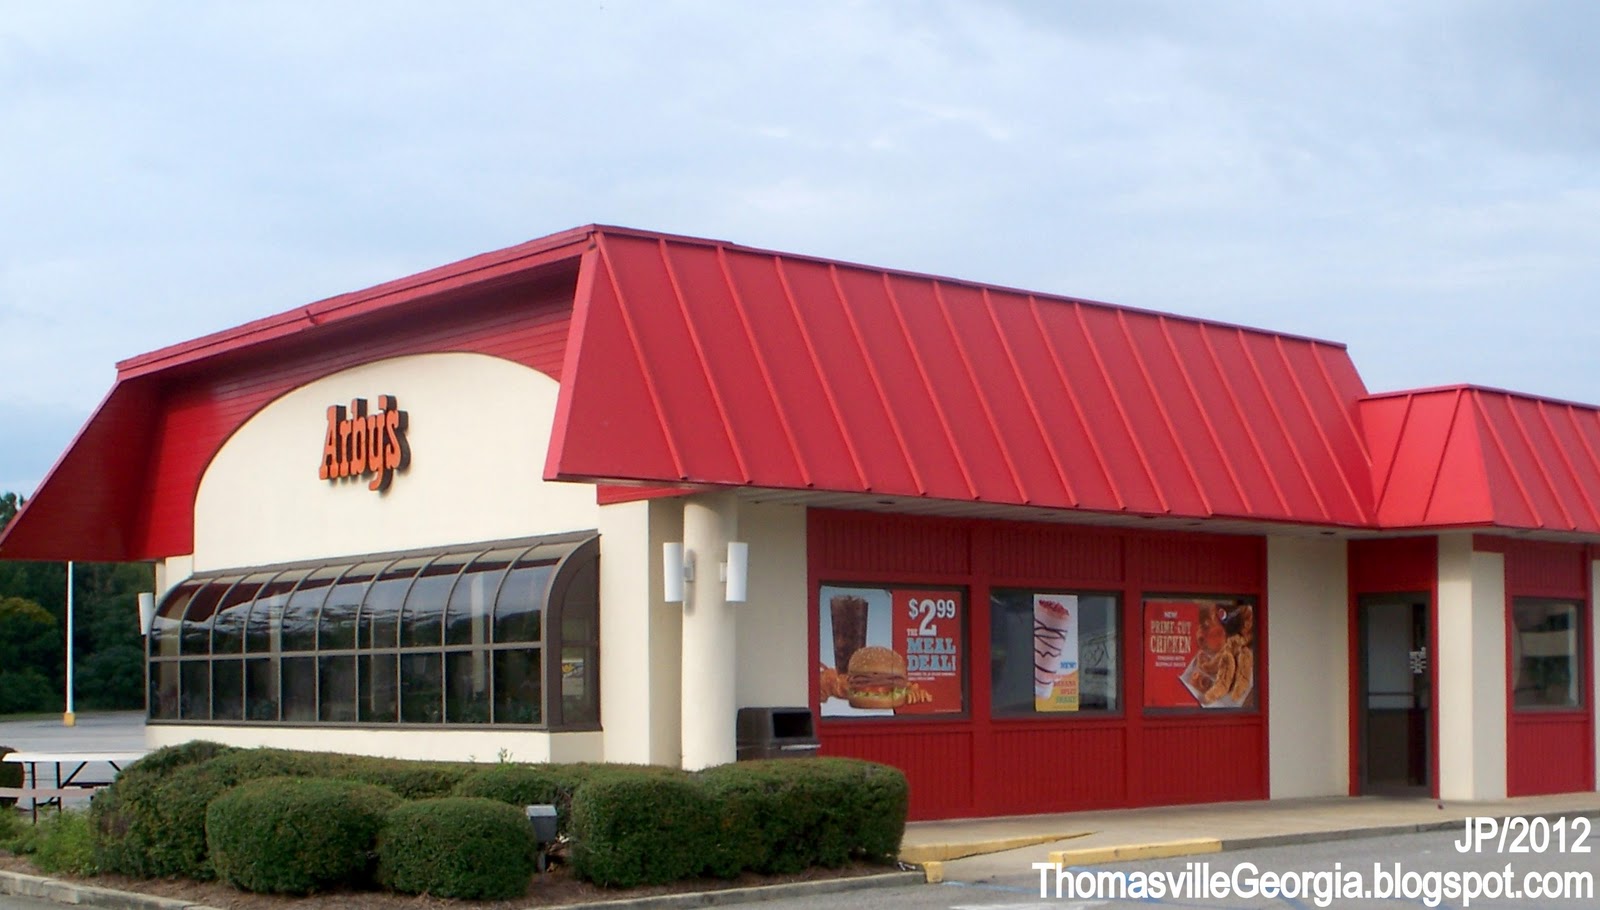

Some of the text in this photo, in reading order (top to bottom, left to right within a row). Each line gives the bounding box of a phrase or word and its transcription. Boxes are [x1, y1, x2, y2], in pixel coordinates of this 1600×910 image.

[319, 394, 409, 492] Arby's
[906, 637, 956, 654] MEAL
[1150, 635, 1191, 654] CHICKEN
[906, 654, 956, 672] DEAL!
